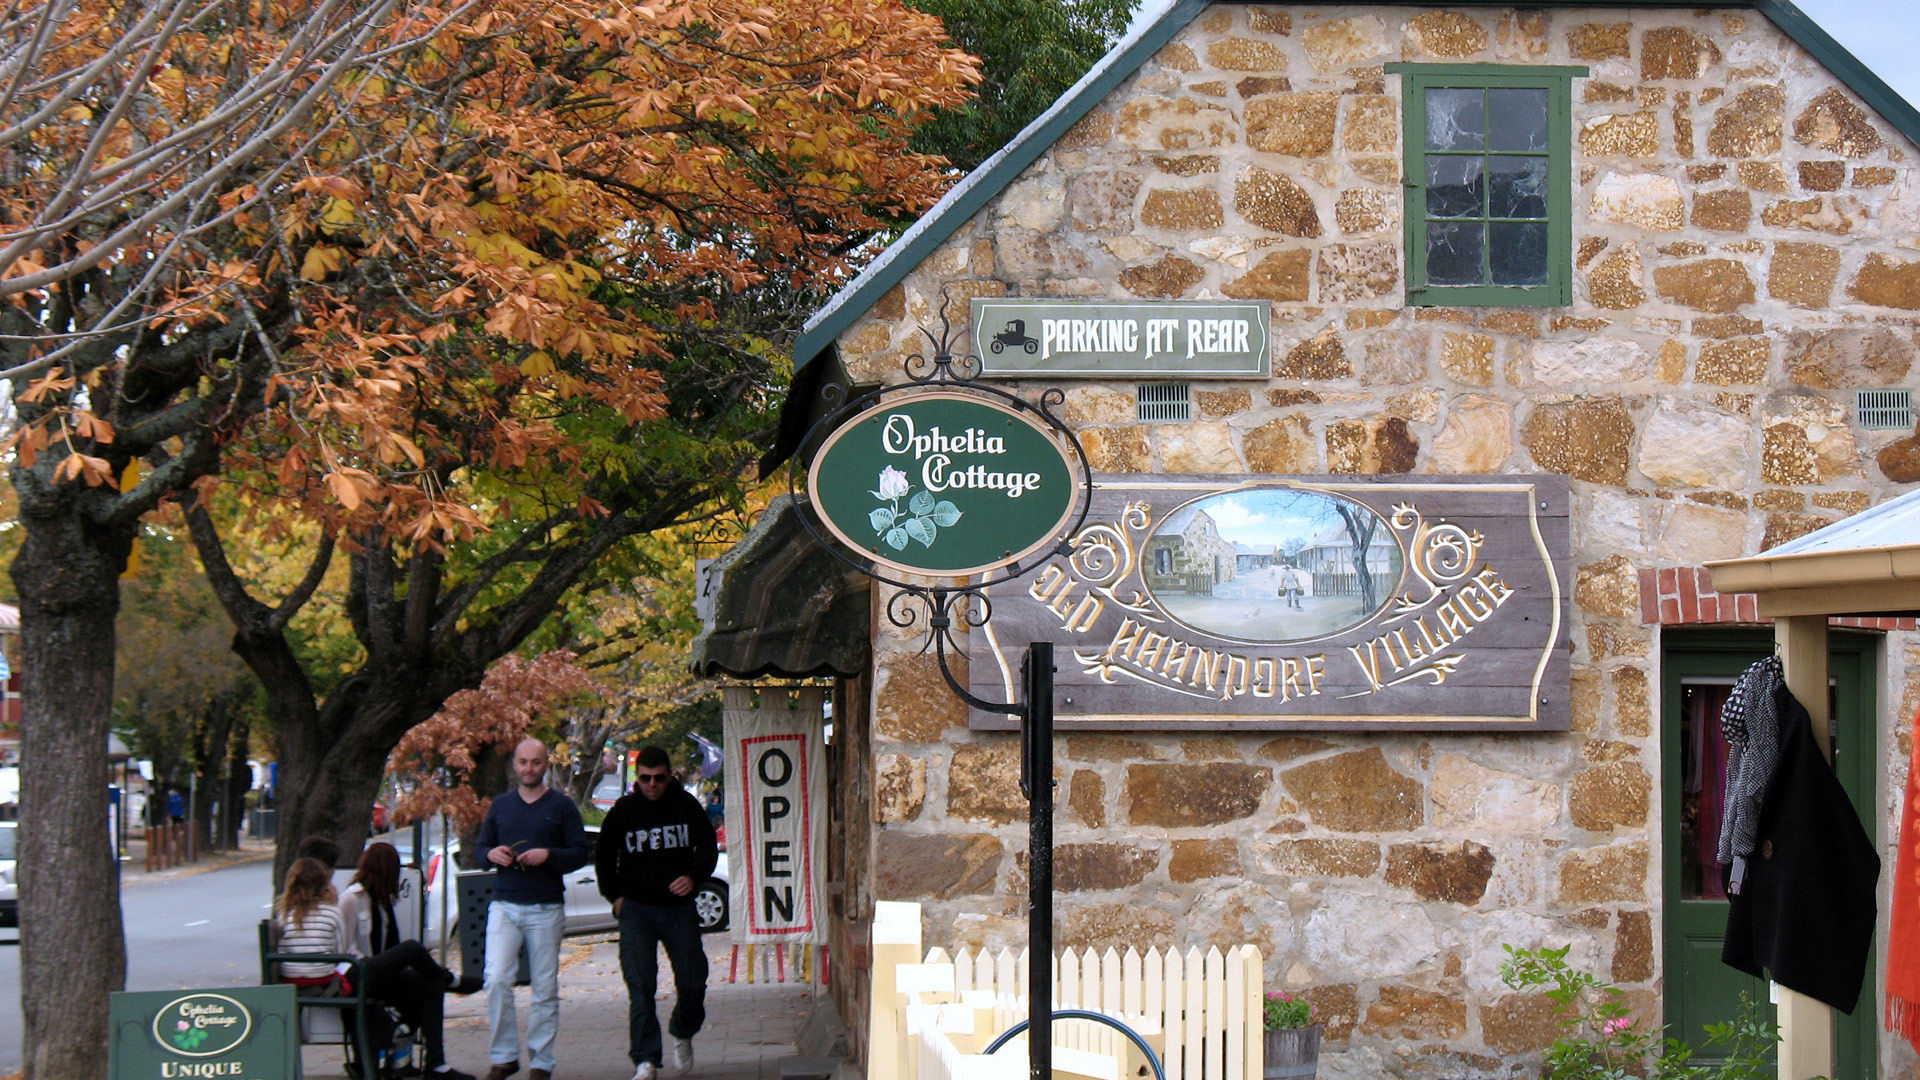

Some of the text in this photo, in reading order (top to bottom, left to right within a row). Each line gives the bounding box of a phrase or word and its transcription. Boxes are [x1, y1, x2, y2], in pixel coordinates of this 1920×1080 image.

[1041, 318, 1250, 360] PARKING AT REAR
[882, 414, 1007, 459] Ophelia
[921, 453, 1041, 498] Cottage
[1028, 562, 1514, 704] OLD HAHNDORF VILLAGE
[758, 747, 794, 923] OPEN
